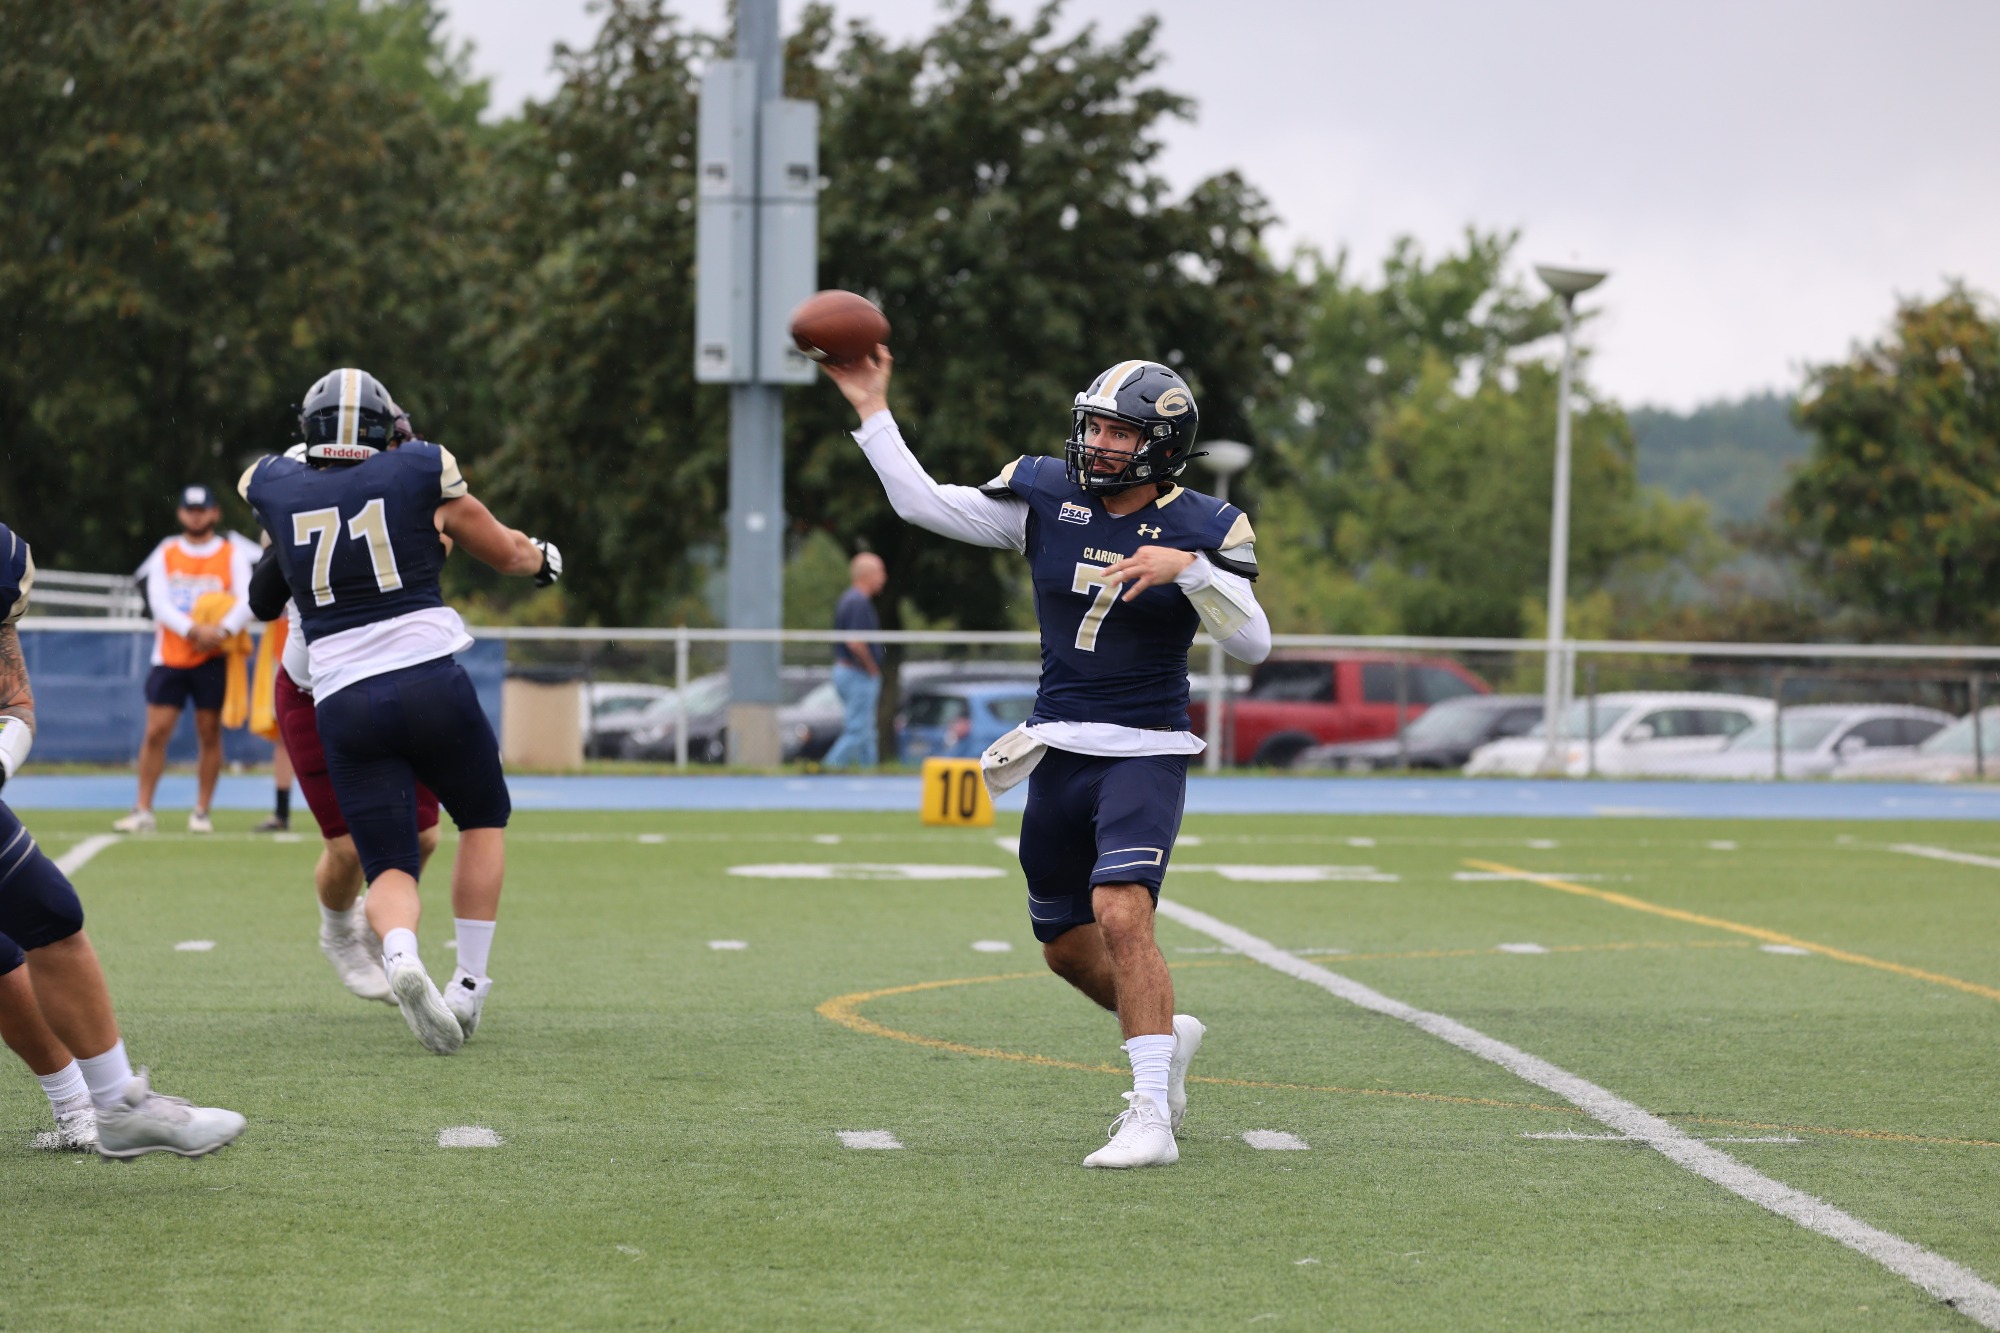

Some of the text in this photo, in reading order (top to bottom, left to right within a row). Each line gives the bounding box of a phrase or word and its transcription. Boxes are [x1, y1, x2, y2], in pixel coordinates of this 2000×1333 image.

[323, 447, 370, 459] Riddell
[1060, 507, 1090, 521] PSAC
[292, 498, 403, 607] 71
[1083, 546, 1125, 565] CLARION
[1071, 561, 1123, 652] 7
[940, 769, 978, 819] 10
